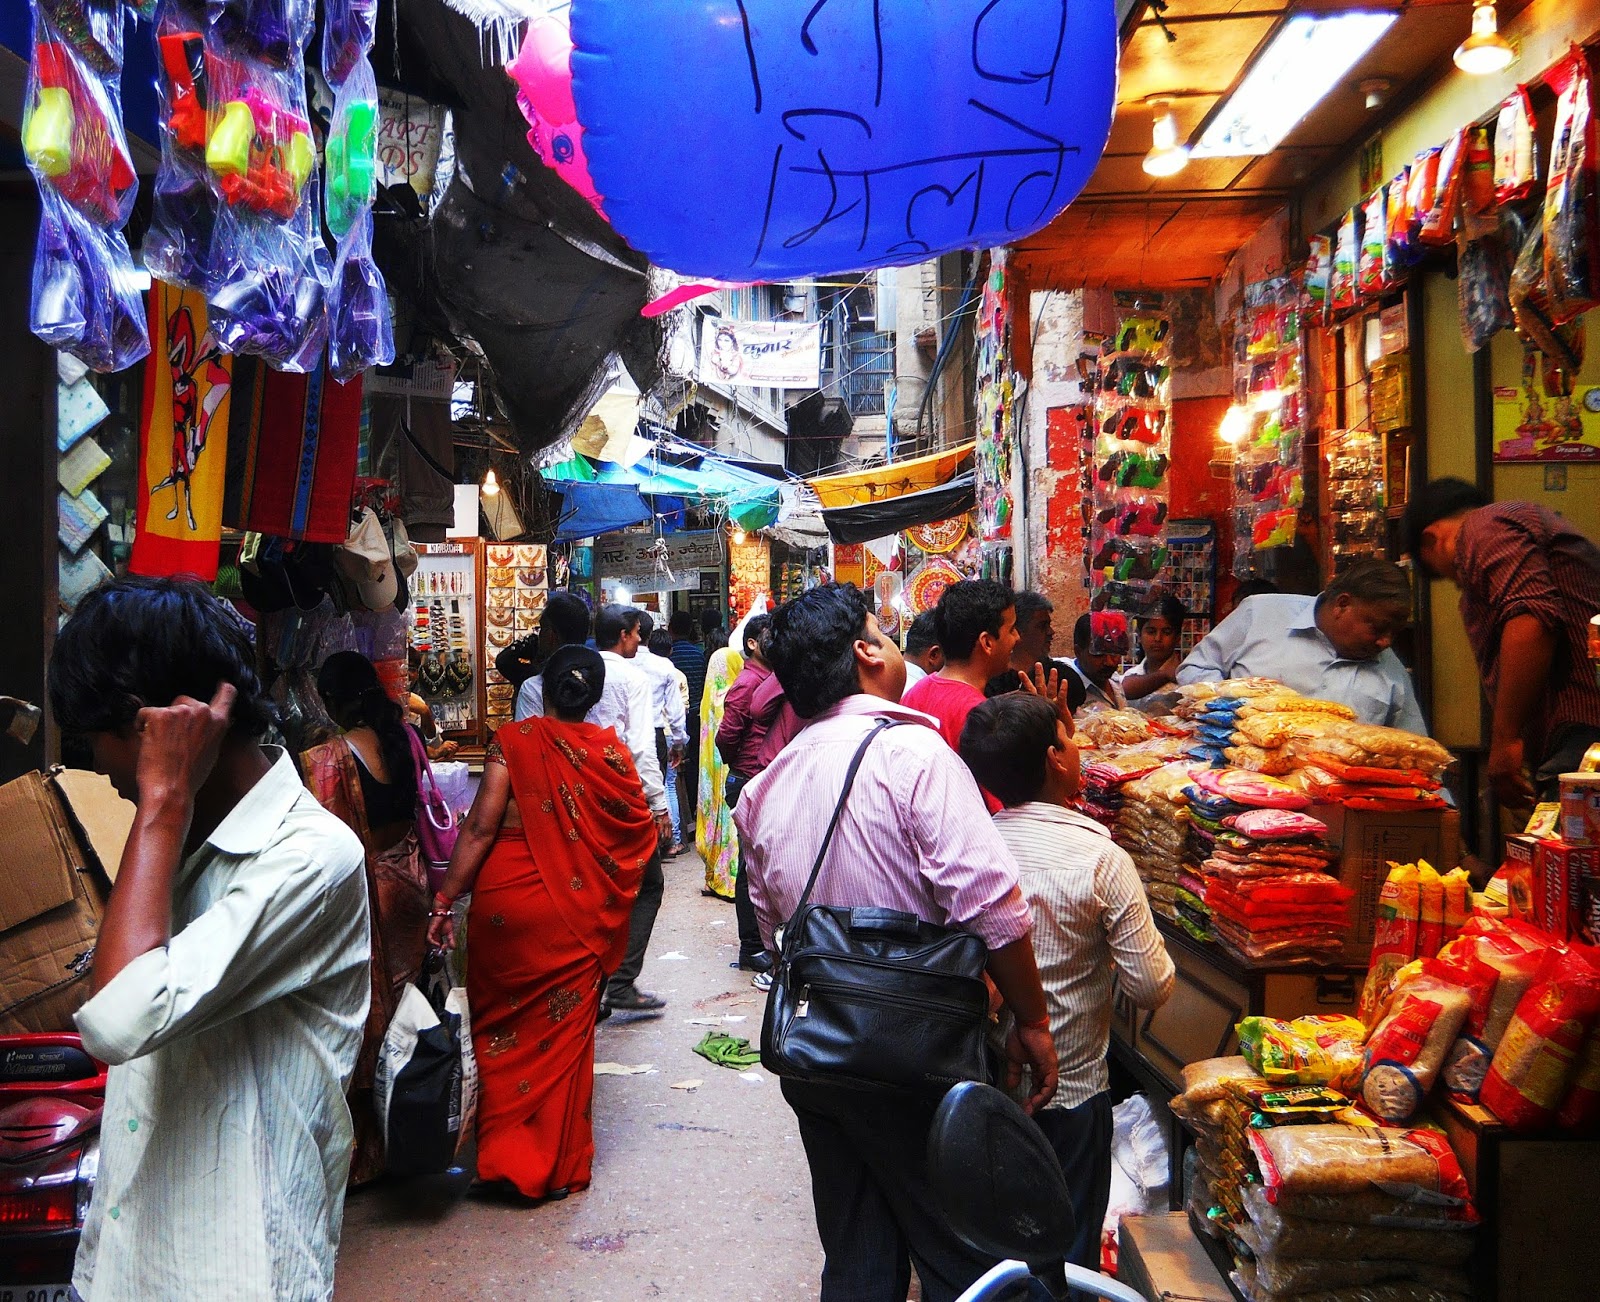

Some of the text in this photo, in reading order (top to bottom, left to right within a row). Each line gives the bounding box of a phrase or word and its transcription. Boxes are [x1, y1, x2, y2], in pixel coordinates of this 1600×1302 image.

[742, 339, 792, 359] कुमार
[430, 544, 437, 552] NO
[1553, 854, 1562, 901] Lotte
